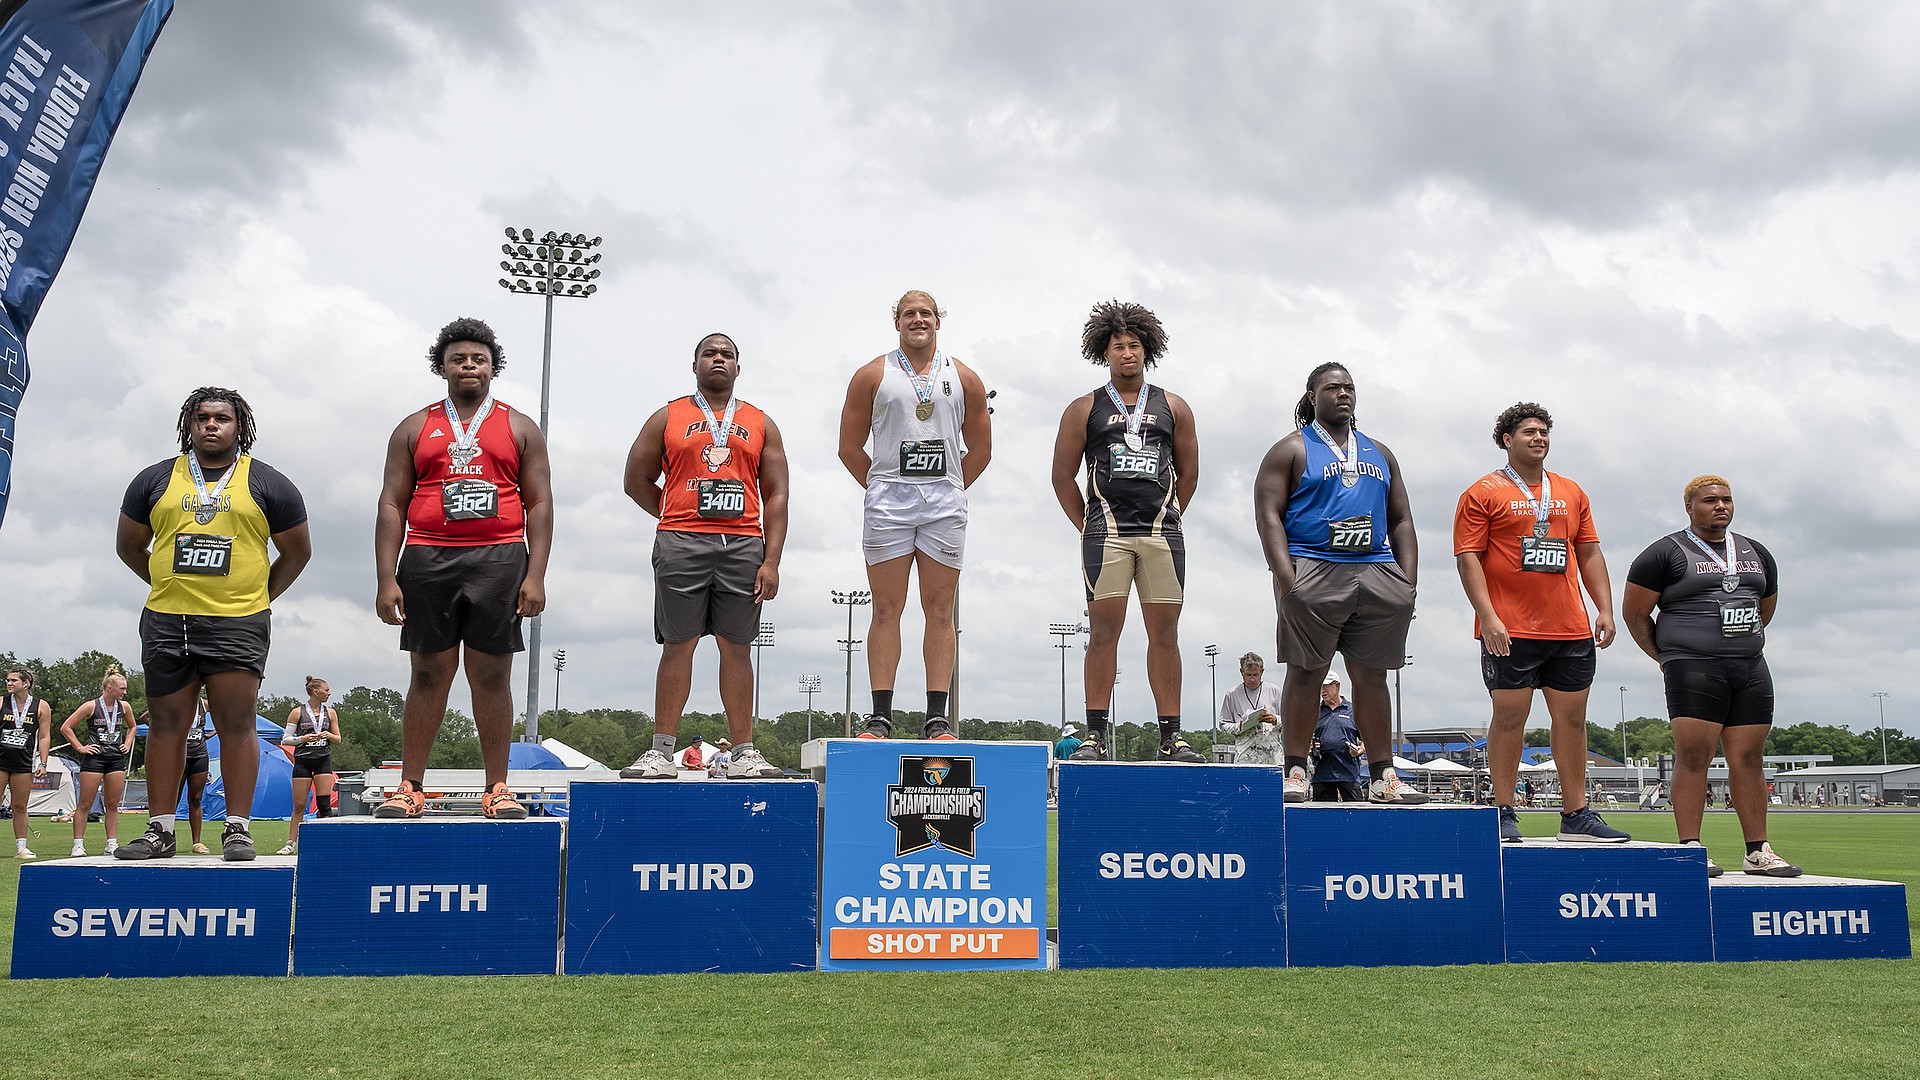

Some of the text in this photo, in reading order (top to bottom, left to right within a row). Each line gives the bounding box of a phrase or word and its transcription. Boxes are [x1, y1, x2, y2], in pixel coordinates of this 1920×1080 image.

[0, 34, 52, 132] TRACK
[27, 64, 91, 164] FLORIDA
[1, 158, 51, 228] HIGH
[449, 465, 483, 475] TRACK
[905, 453, 943, 470] 2971
[1113, 455, 1158, 474] 3326
[450, 492, 494, 513] 3621
[699, 493, 744, 511] 3400
[1332, 528, 1372, 546] 2773
[178, 548, 226, 568] 3130
[1523, 548, 1567, 567] 2806
[1, 735, 27, 746] 3228
[903, 786, 918, 794] 2024
[918, 786, 935, 794] FHSAA
[957, 787, 971, 795] FIELD
[891, 790, 982, 819] CHAMPIONSHIPS
[632, 863, 754, 891] THIRD
[878, 863, 991, 890] STATE
[1098, 852, 1246, 879] SECOND
[369, 884, 488, 914] FIFTH
[1325, 873, 1464, 900] FOURTH
[835, 896, 1032, 924] CHAMPION
[1558, 892, 1657, 918] SIXTH
[51, 908, 256, 938] SEVENTH
[1752, 909, 1870, 936] EIGHTH
[867, 933, 1004, 953] SHOT PUT
